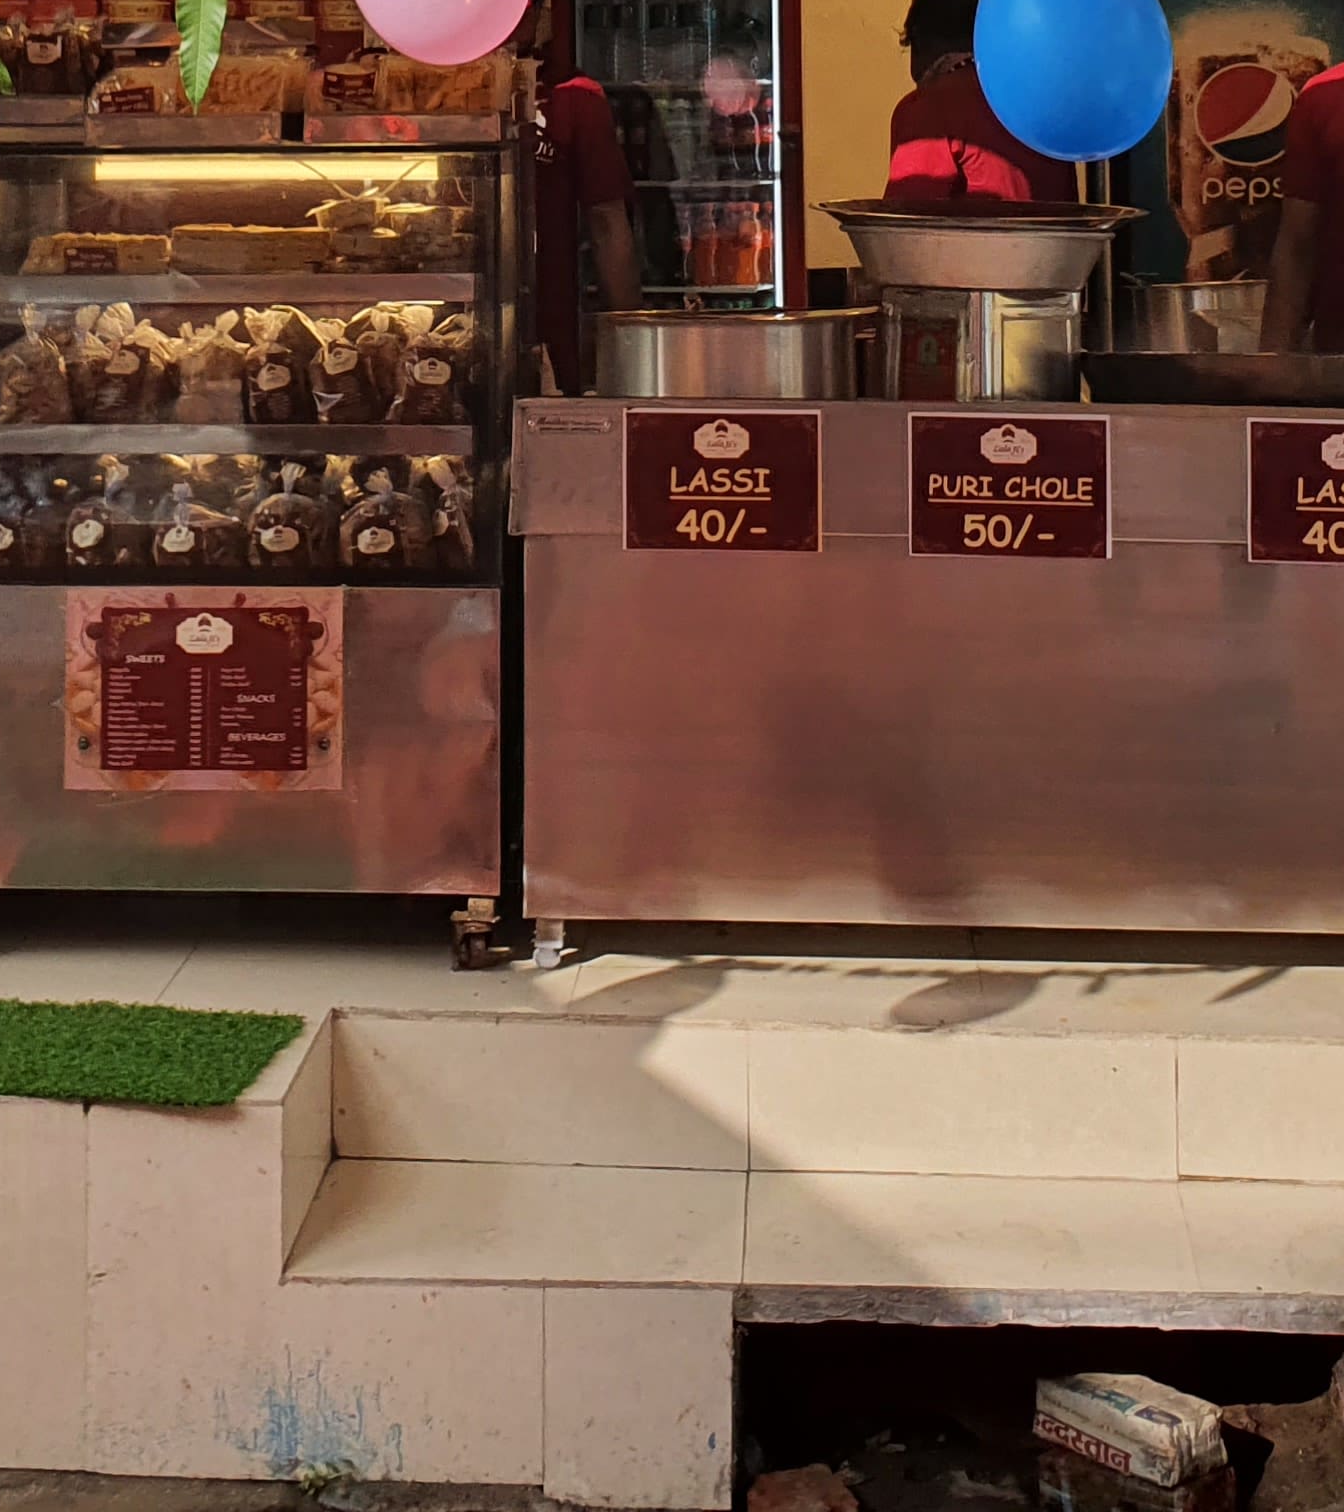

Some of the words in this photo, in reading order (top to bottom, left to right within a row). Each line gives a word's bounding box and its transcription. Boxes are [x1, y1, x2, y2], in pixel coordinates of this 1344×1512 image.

[1202, 176, 1285, 206] peps
[669, 465, 772, 494] LASSI
[927, 473, 994, 498] PURI
[1004, 476, 1095, 502] CHOLE
[675, 507, 768, 544] 40/-
[963, 513, 1056, 550] 50/-
